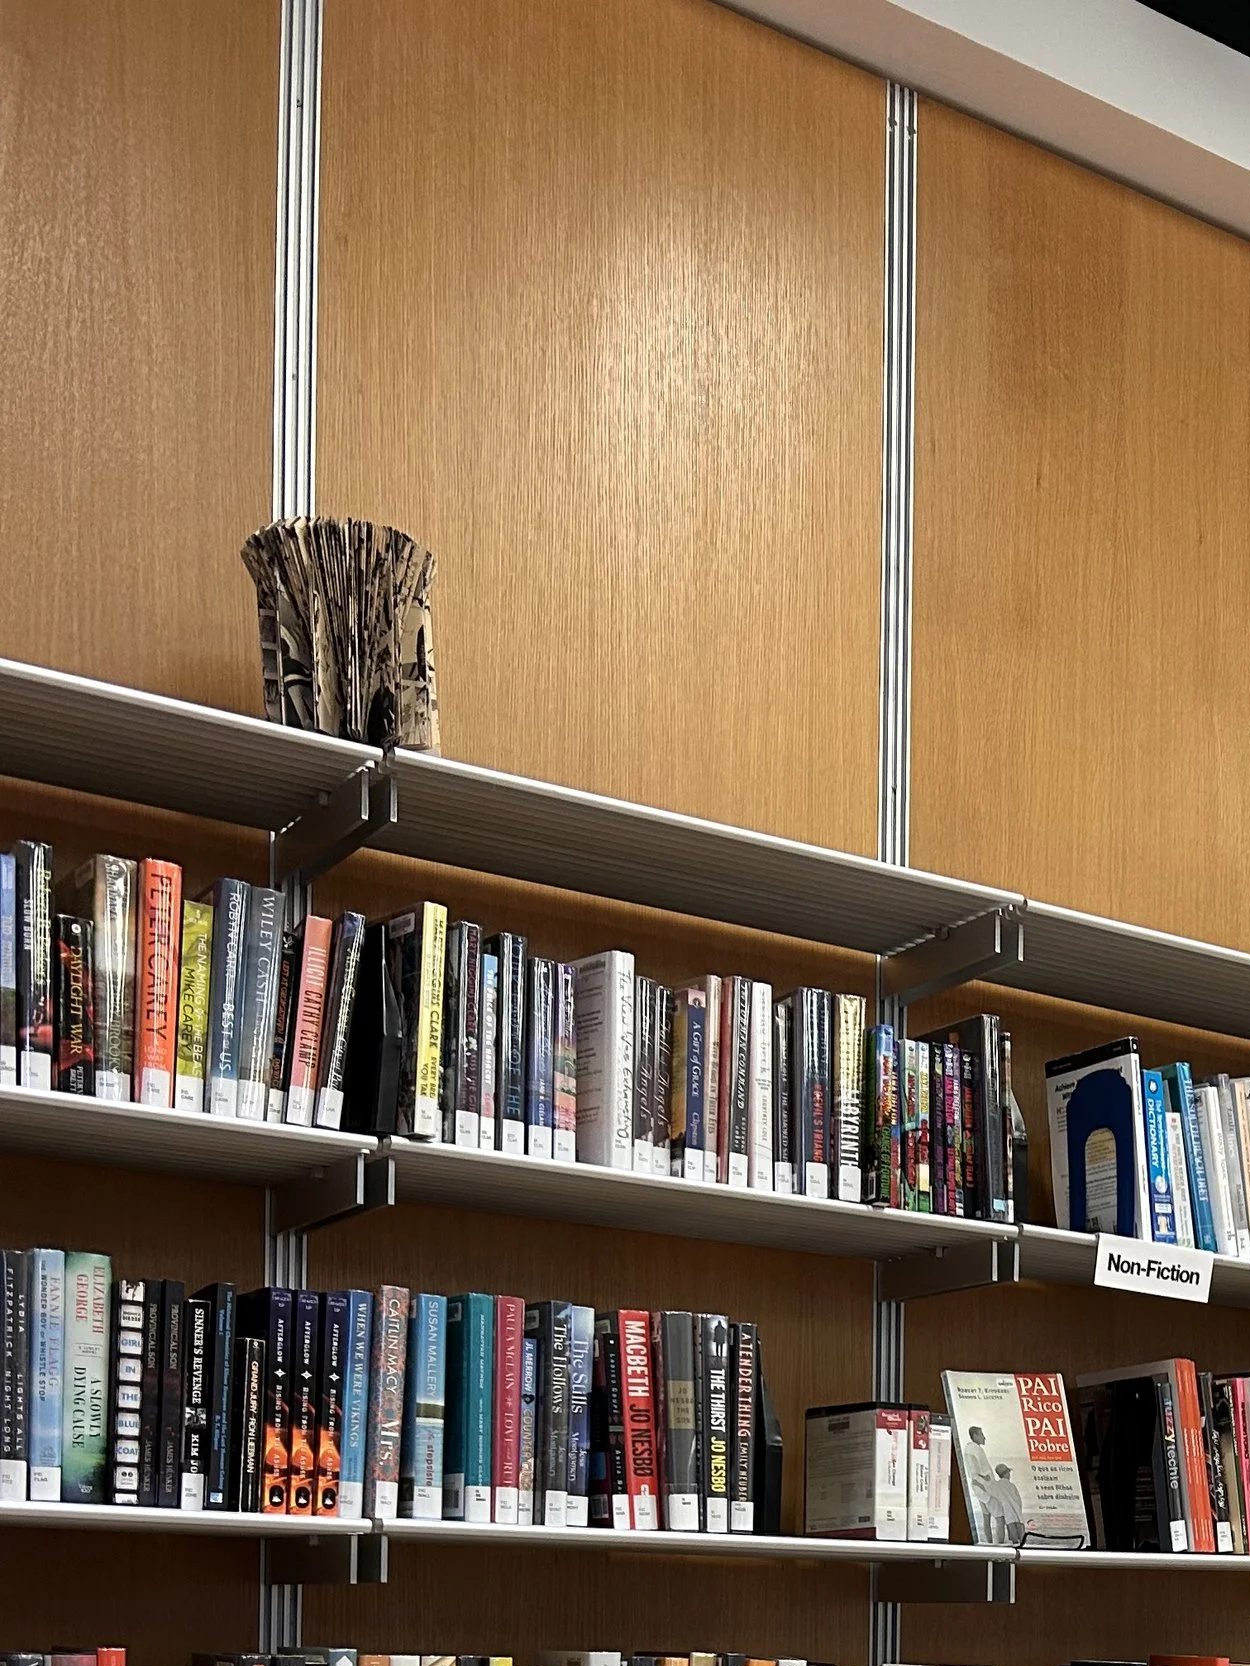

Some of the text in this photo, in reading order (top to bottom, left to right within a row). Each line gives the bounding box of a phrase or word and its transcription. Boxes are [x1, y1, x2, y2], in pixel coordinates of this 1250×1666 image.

[146, 873, 171, 1040] PETER CAREY
[256, 898, 275, 1002] WILEY CASH
[70, 946, 82, 1054] DAYLIGHT WAR
[181, 968, 195, 1051] MIKE CAREY
[299, 947, 326, 1069] ILLICIT CATHY CLAMP
[841, 1090, 859, 1169] LABYRINTH
[1148, 1099, 1158, 1168] DICTIONARY
[1107, 1253, 1201, 1286] Non-Fiction
[72, 1274, 88, 1448] GEORGE DYING CAUSE
[350, 1303, 367, 1447] WHEN WE WERE VIKINGS
[379, 1300, 399, 1465] CAITLIN MACY Mrs.
[552, 1325, 567, 1413] The Hollows
[572, 1340, 587, 1414] The Stills
[625, 1321, 654, 1477] MACBETH JO NESBØ
[1017, 1377, 1058, 1396] PAI
[1024, 1397, 1062, 1412] Rico
[711, 1369, 726, 1492] THE THIRST JO NESBØ
[1025, 1417, 1066, 1437] PAI
[1029, 1439, 1069, 1452] Pobre
[1163, 1399, 1179, 1489] fuzzy techie
